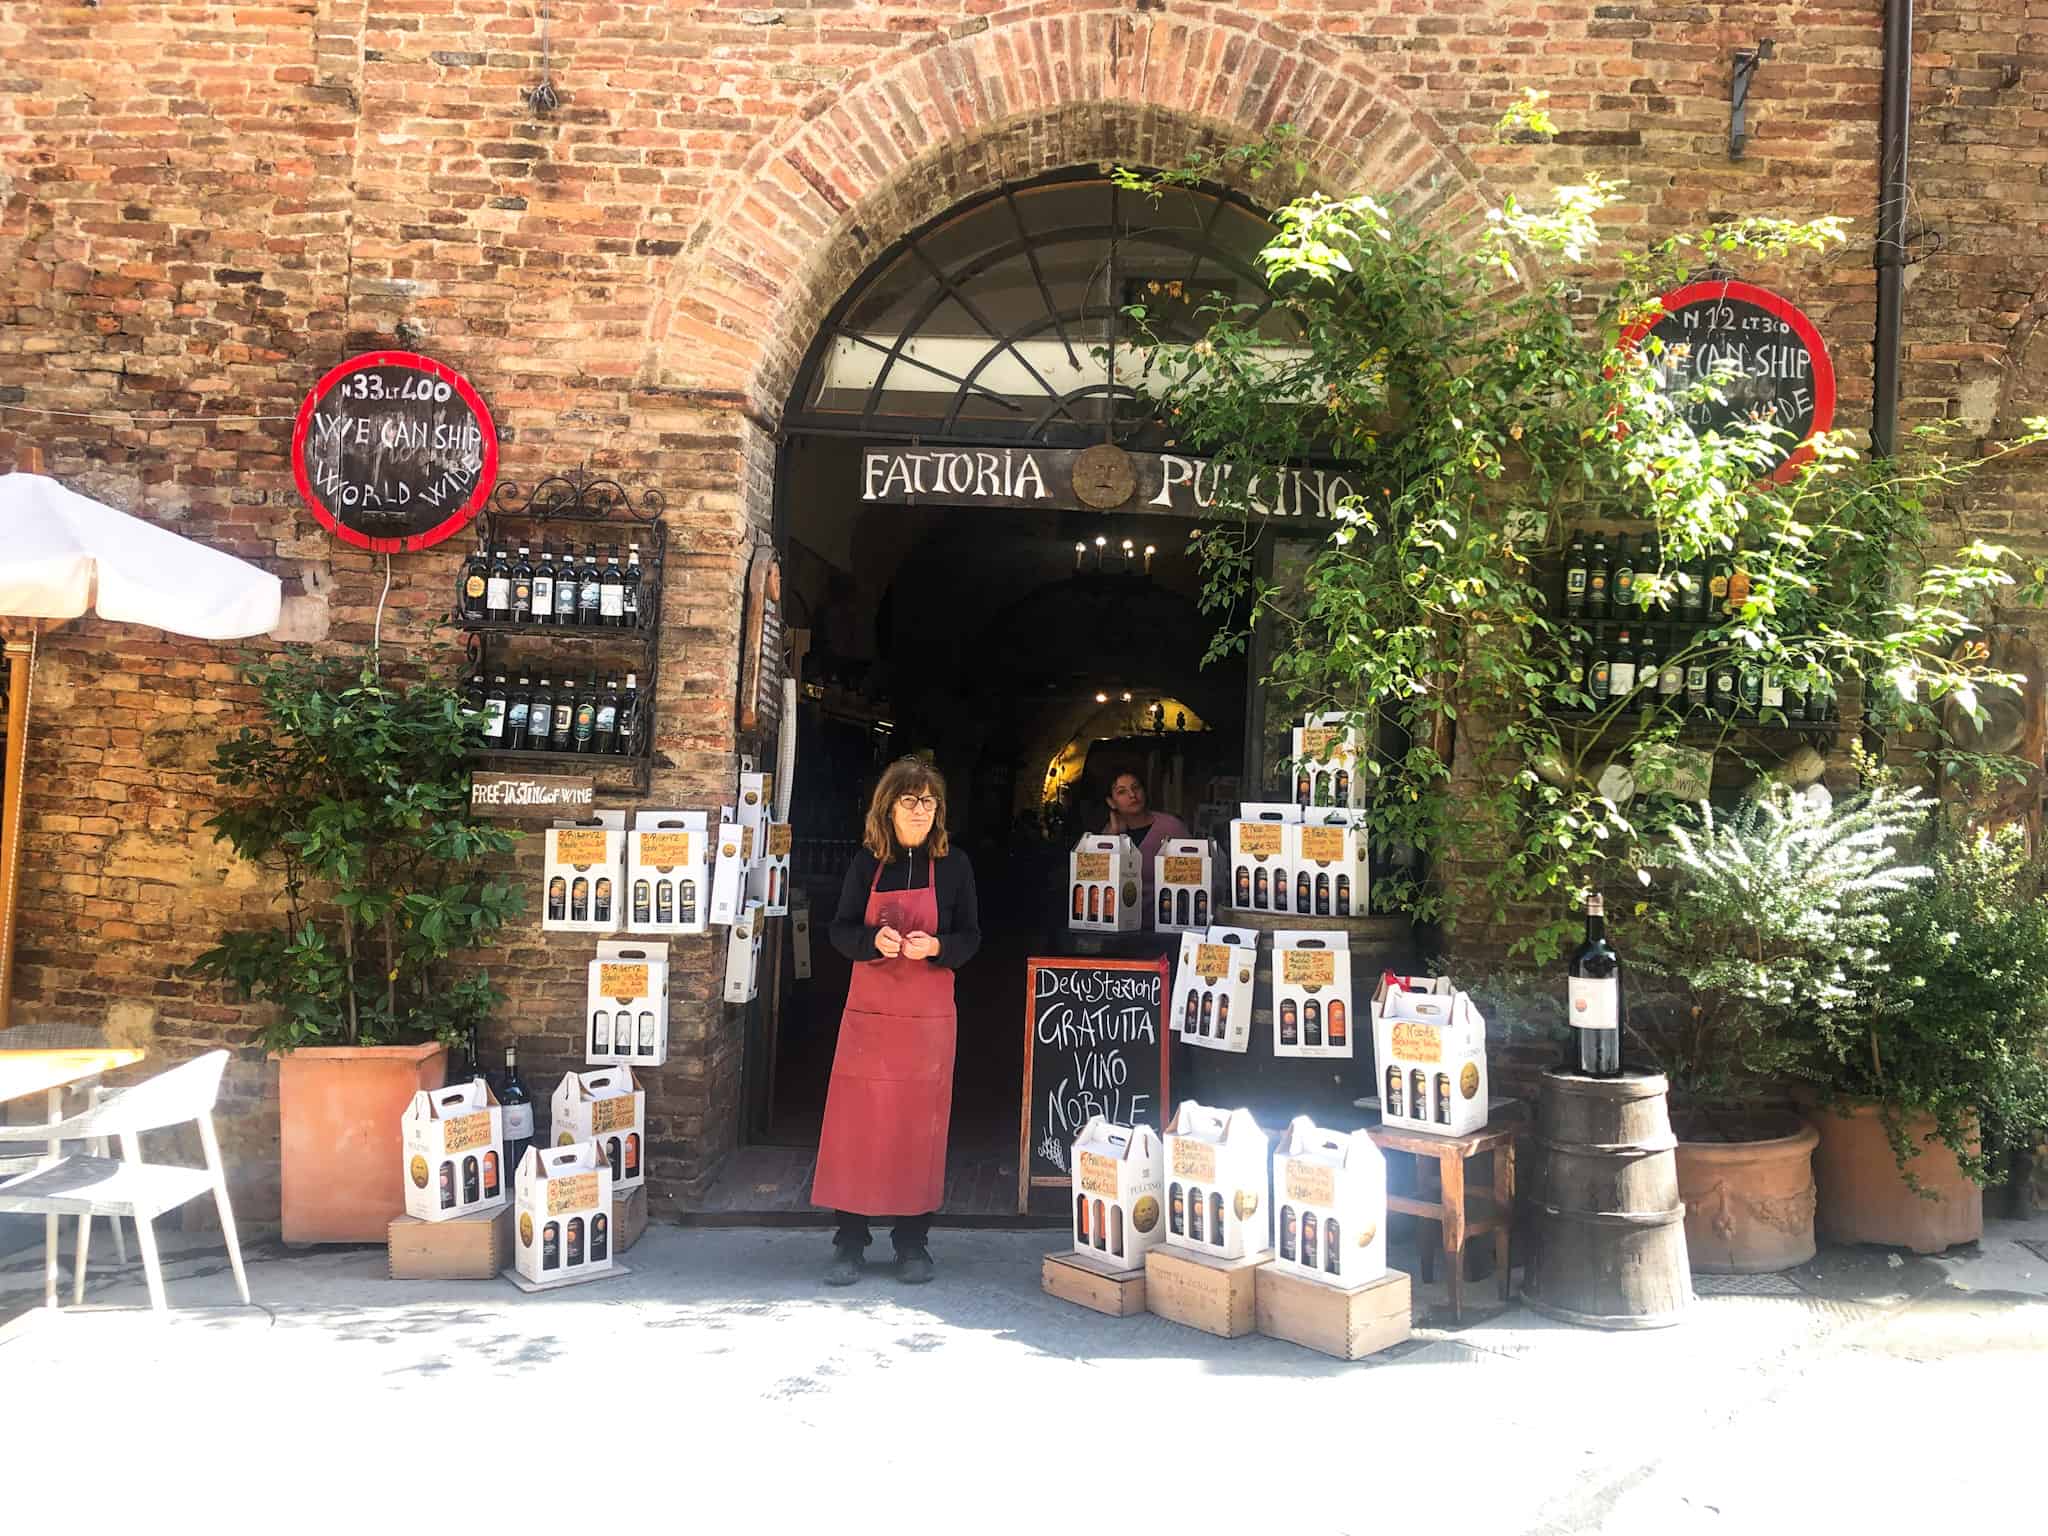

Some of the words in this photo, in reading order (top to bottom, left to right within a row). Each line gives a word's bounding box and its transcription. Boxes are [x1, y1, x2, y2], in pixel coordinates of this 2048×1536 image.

[1705, 306, 1737, 330] 12
[353, 374, 385, 400] 33
[315, 412, 371, 443] WE
[381, 419, 428, 448] CAN
[435, 424, 481, 450] SHIP
[316, 460, 411, 506] WORLD
[419, 452, 482, 507] WIDE
[862, 449, 1047, 499] FATTORIA
[561, 787, 592, 804] WINE
[1038, 1002, 1155, 1051] GRATUITA
[1074, 1050, 1127, 1090] VINO
[1049, 1078, 1150, 1136] NOBILE
